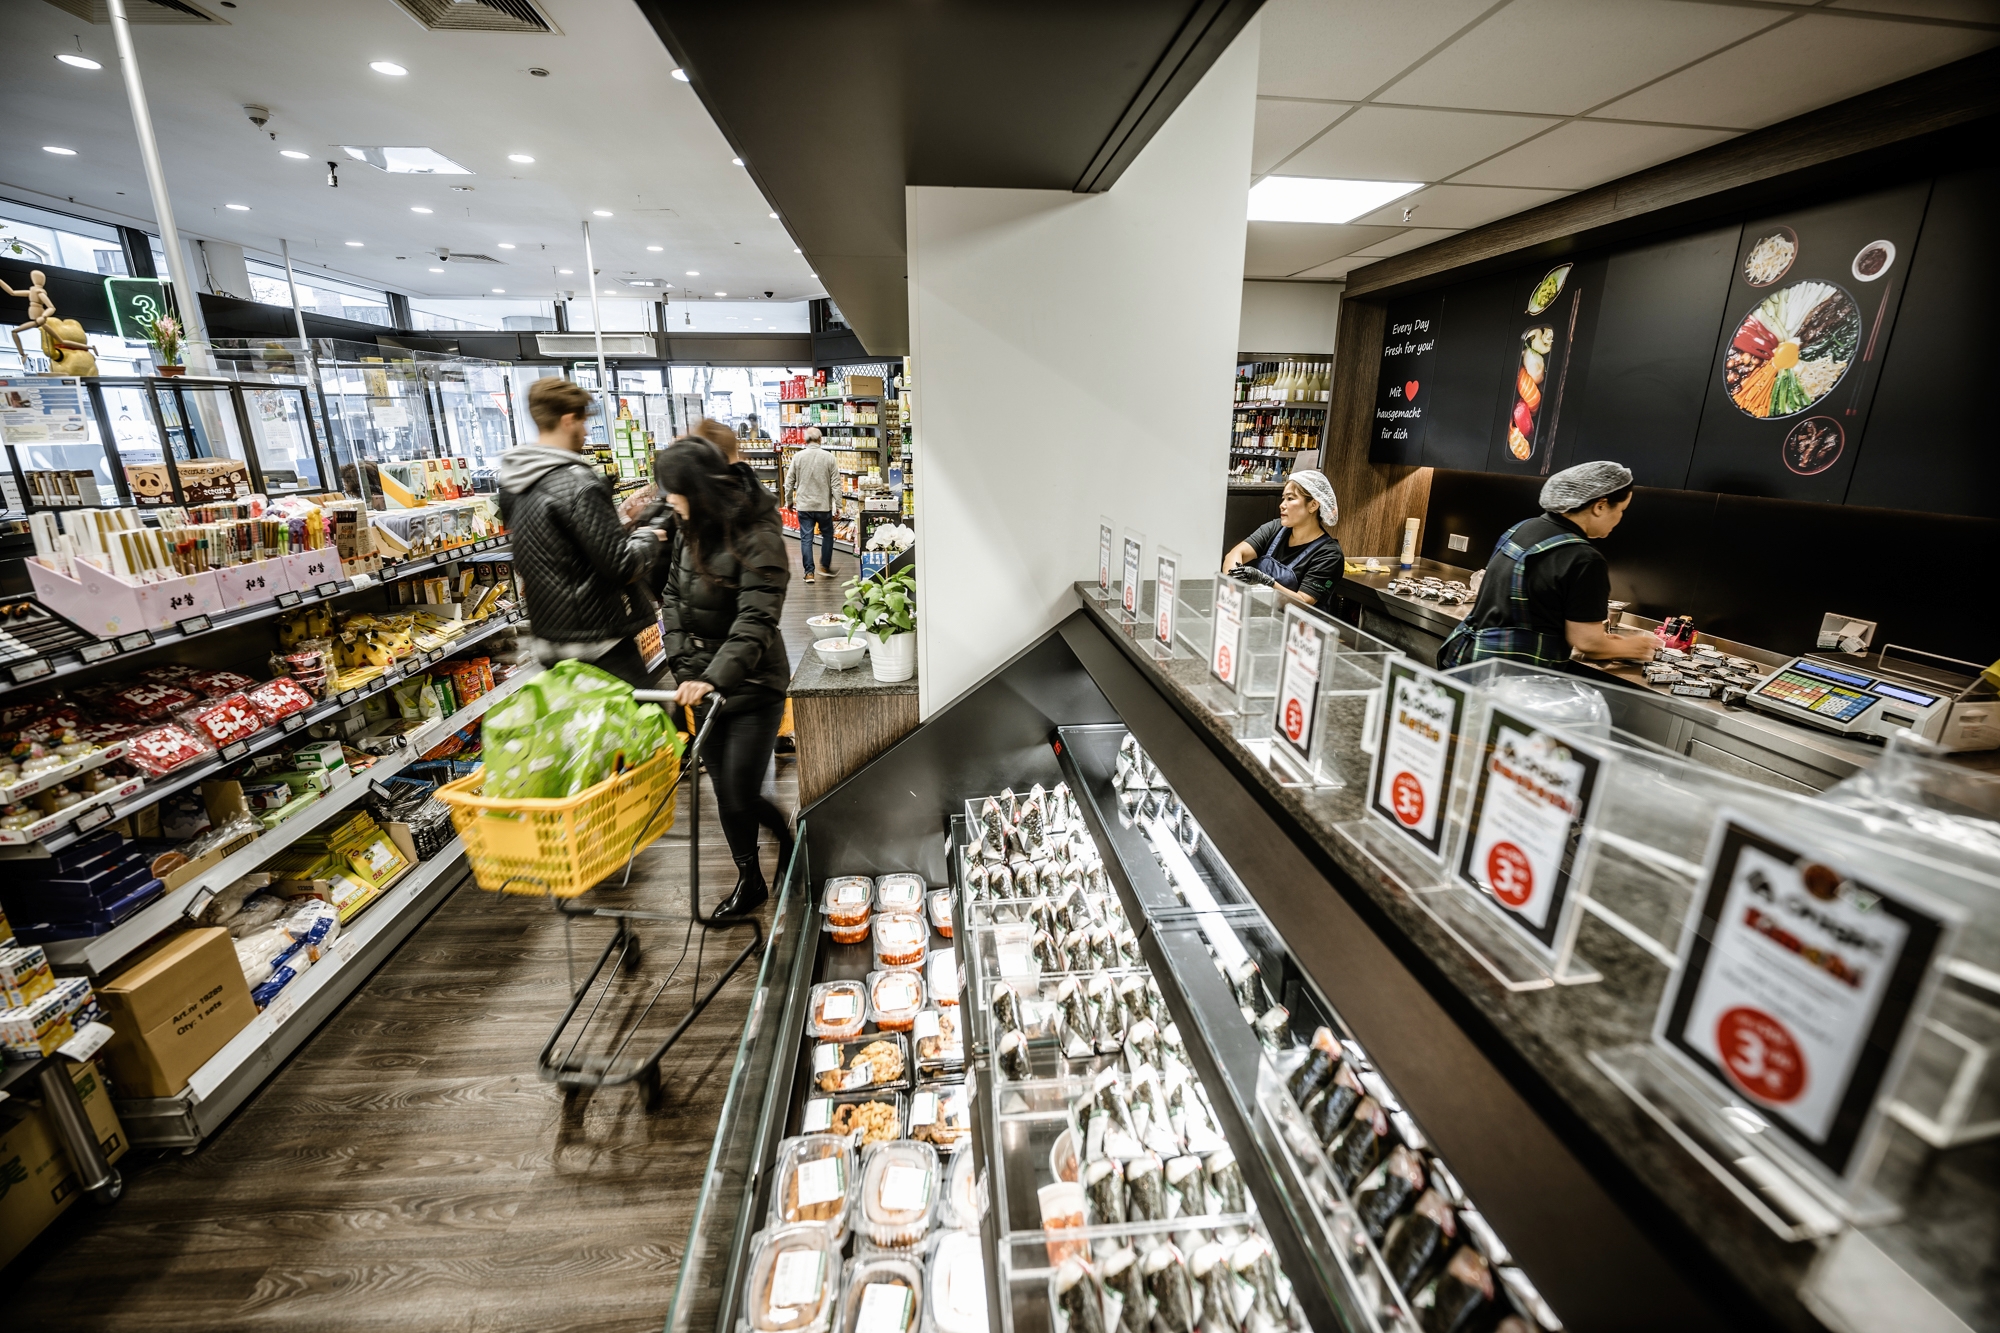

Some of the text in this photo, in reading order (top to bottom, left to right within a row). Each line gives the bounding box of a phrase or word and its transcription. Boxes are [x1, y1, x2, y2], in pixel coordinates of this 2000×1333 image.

[132, 294, 160, 327] 3
[1392, 319, 1430, 335] Every Day
[1384, 339, 1435, 357] Fresh for you!
[1389, 385, 1402, 398] Mit
[1376, 406, 1422, 422] hausgemacht
[1381, 427, 1408, 440] für dich
[172, 1003, 198, 1025] Art.nr
[176, 1019, 198, 1036] Qty:
[204, 1000, 222, 1016] sets
